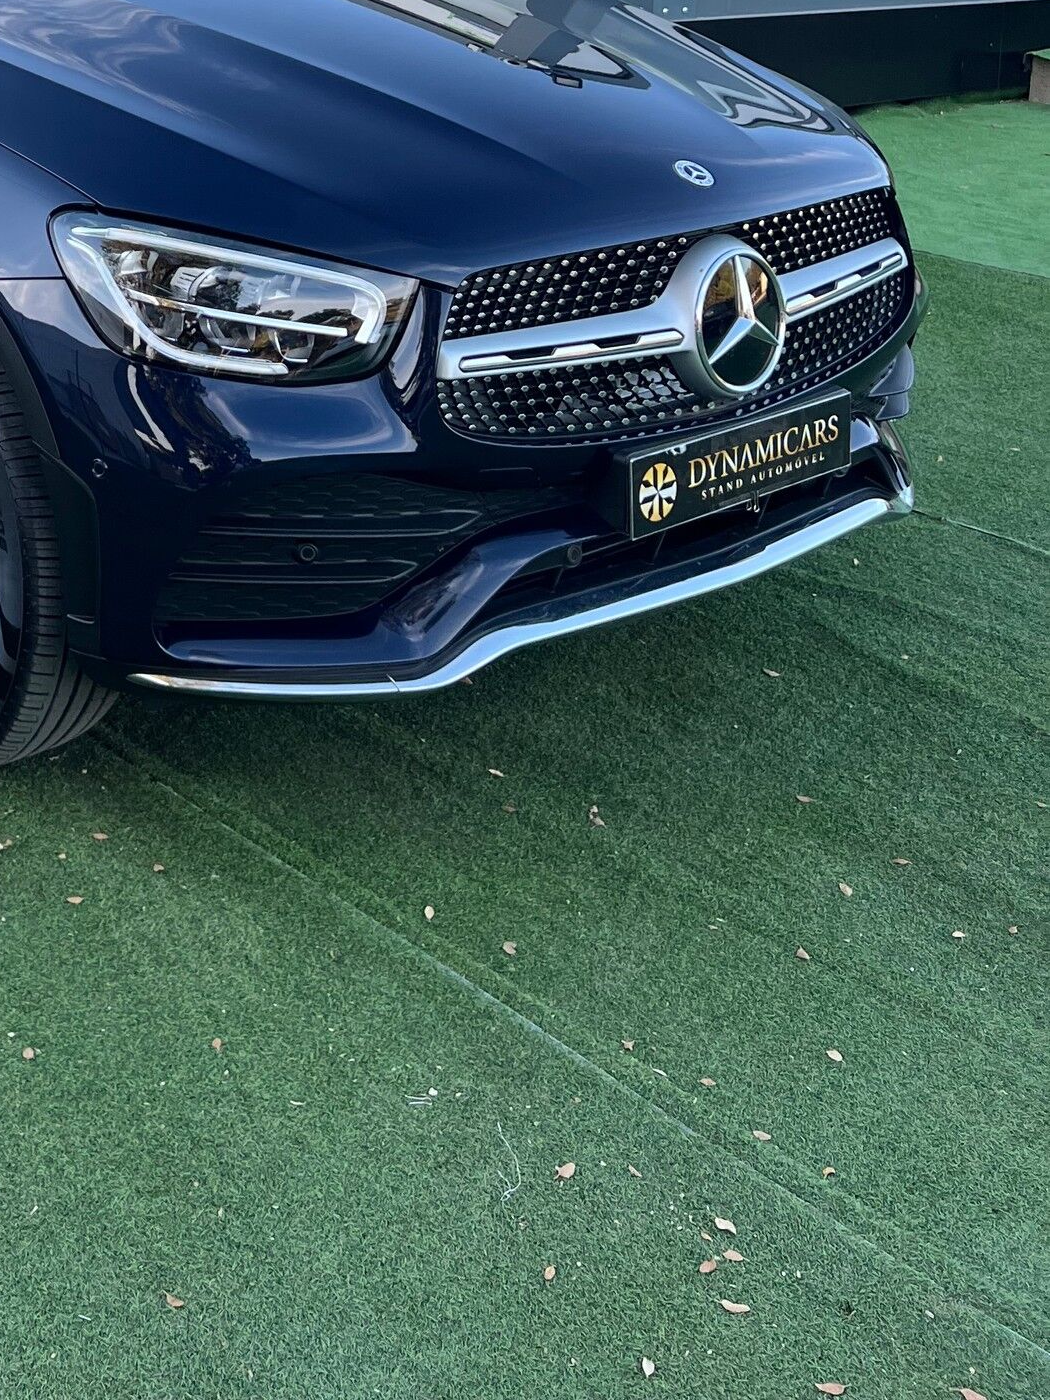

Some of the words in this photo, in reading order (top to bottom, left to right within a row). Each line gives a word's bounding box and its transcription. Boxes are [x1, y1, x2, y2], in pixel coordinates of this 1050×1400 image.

[688, 414, 839, 488] DYNAMICARS
[702, 478, 743, 500] STAND
[750, 451, 825, 485] AUTOMÓVEL
